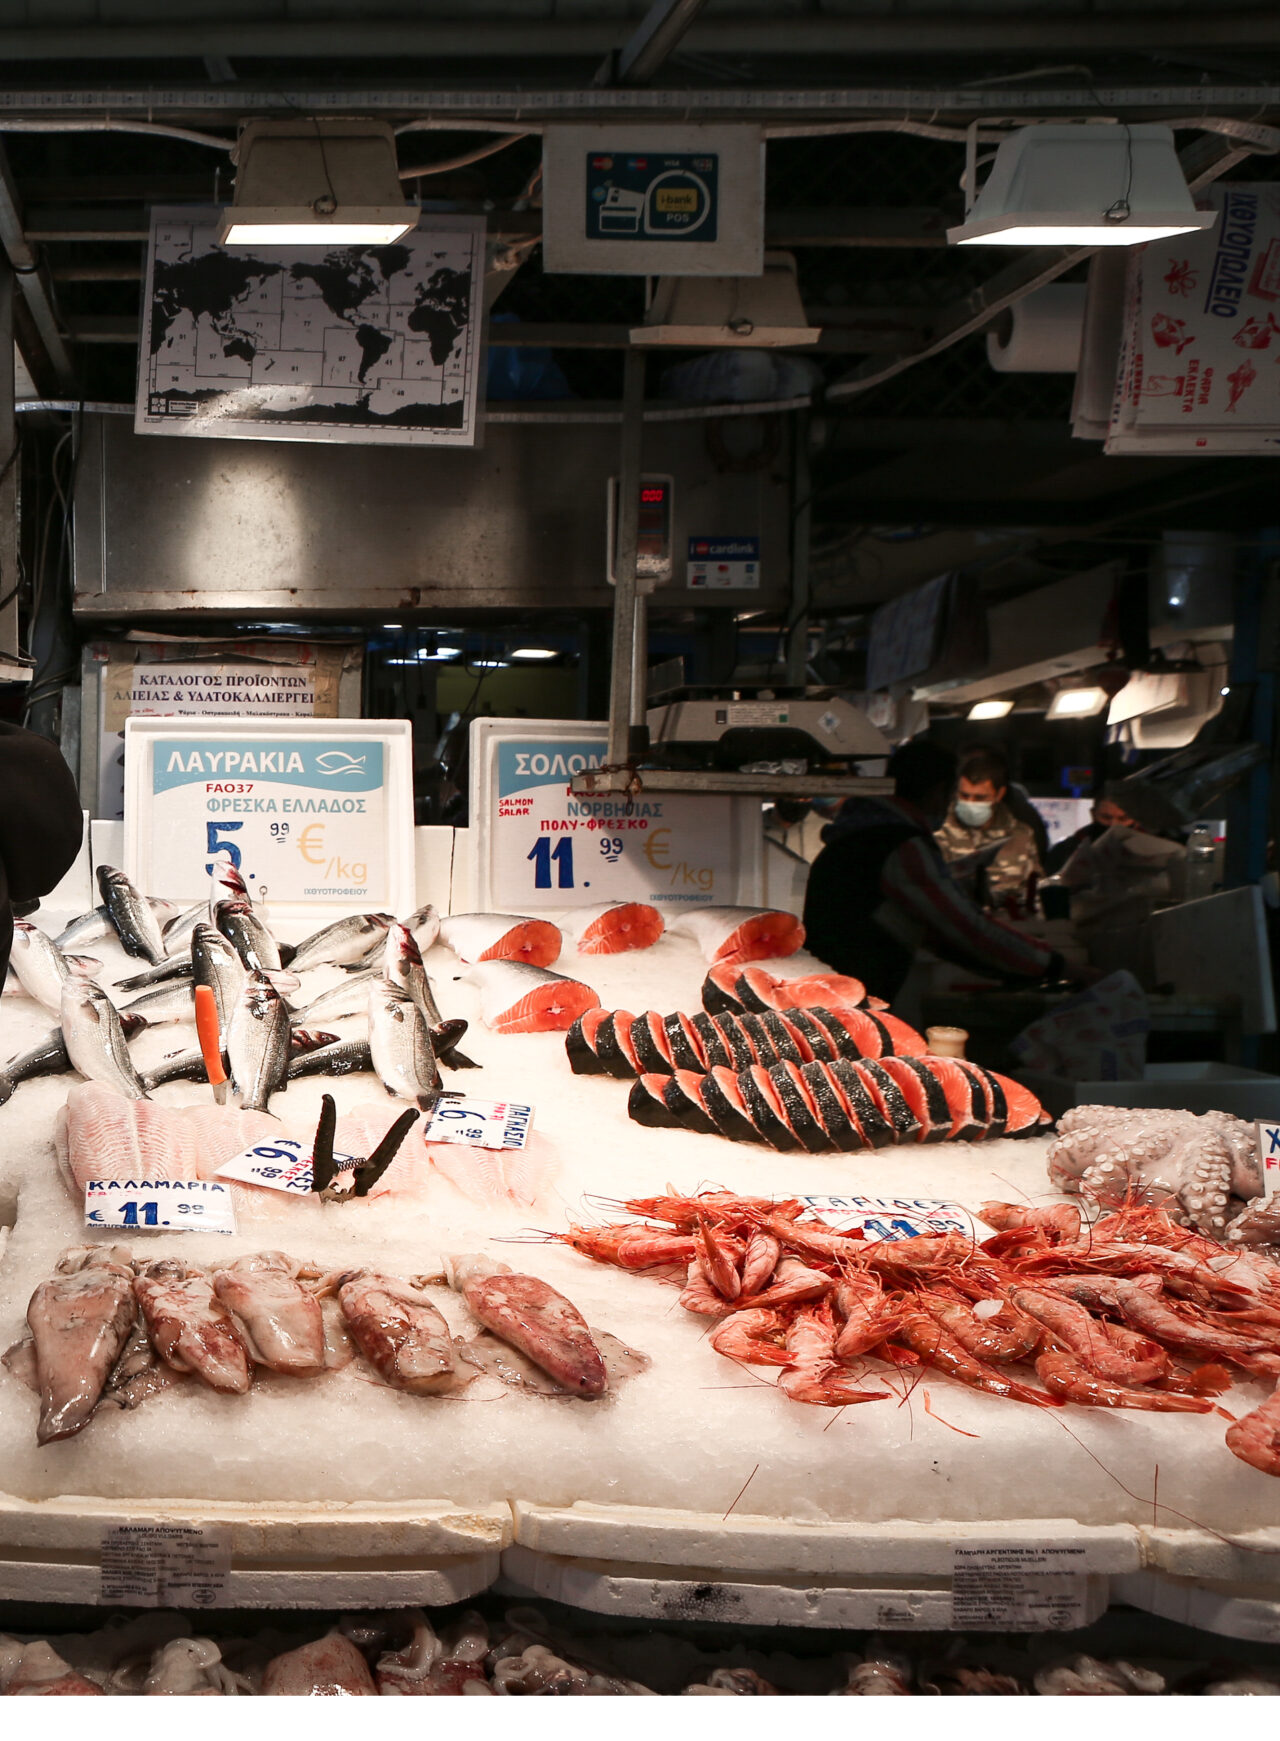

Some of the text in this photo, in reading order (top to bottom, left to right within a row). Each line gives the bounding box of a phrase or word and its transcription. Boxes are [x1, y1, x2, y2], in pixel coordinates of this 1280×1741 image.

[666, 213, 690, 223] POS
[1208, 192, 1258, 319] ΙΧΘΥΟΠΩΛΕΙΟ
[709, 542, 754, 554] cardlink
[140, 675, 222, 687] ΚΑΤΑΛΟΓΟΣ
[114, 690, 170, 701] ΑΛΙΕΙΑΣ
[173, 691, 184, 701] &
[167, 751, 305, 774] ΛΑΥΡΑΚΙΑ
[515, 753, 608, 776] ΣΟΛΟΜ
[206, 783, 254, 793] FAO37
[206, 798, 367, 813] ΦΡΕΣΚΑ ΕΛΛΑΔΟΣ
[498, 798, 534, 807] SALMON
[498, 808, 530, 817] SALAR
[270, 823, 290, 836] 99
[600, 838, 624, 855] 99
[278, 1155, 314, 1181] ΕΣΚΕΣ
[88, 1180, 226, 1193] ΚΑΛΑΜΑΡΙΑ
